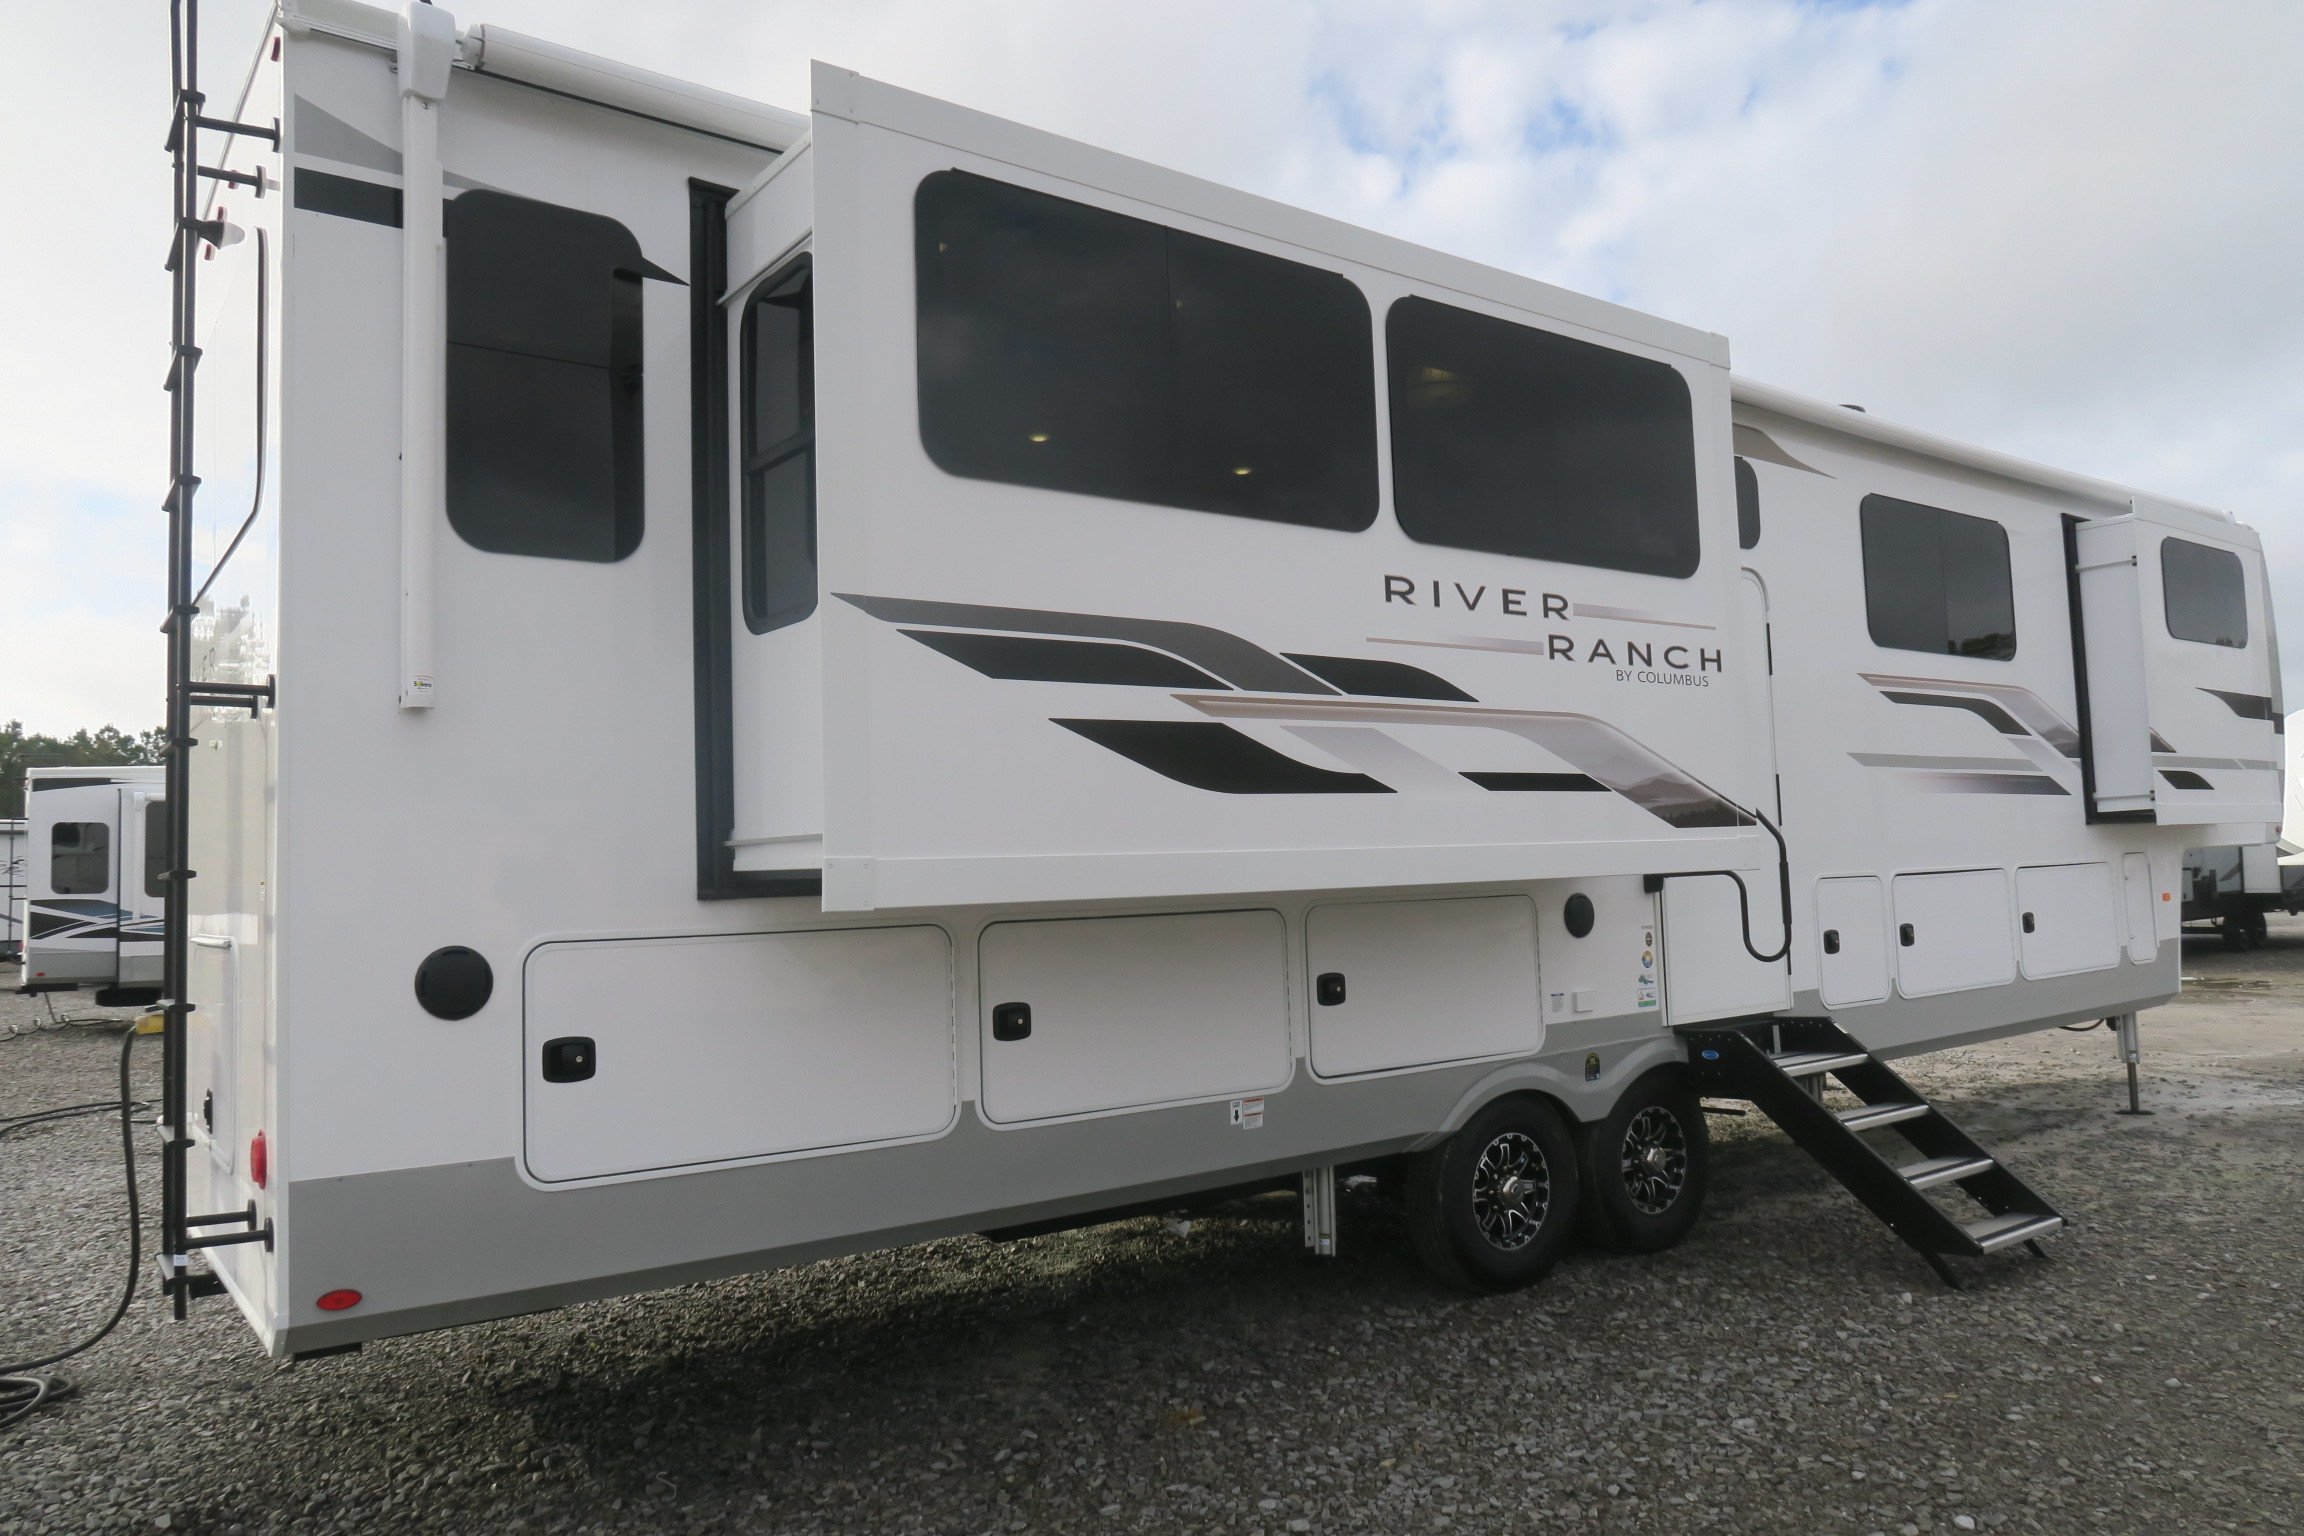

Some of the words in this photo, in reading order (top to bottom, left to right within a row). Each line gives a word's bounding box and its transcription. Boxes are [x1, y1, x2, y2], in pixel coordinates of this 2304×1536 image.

[1383, 573, 1570, 621] RIVER
[1547, 634, 1723, 673] RANCH
[1616, 669, 1632, 682] BY
[1637, 671, 1709, 687] COLUMBUS
